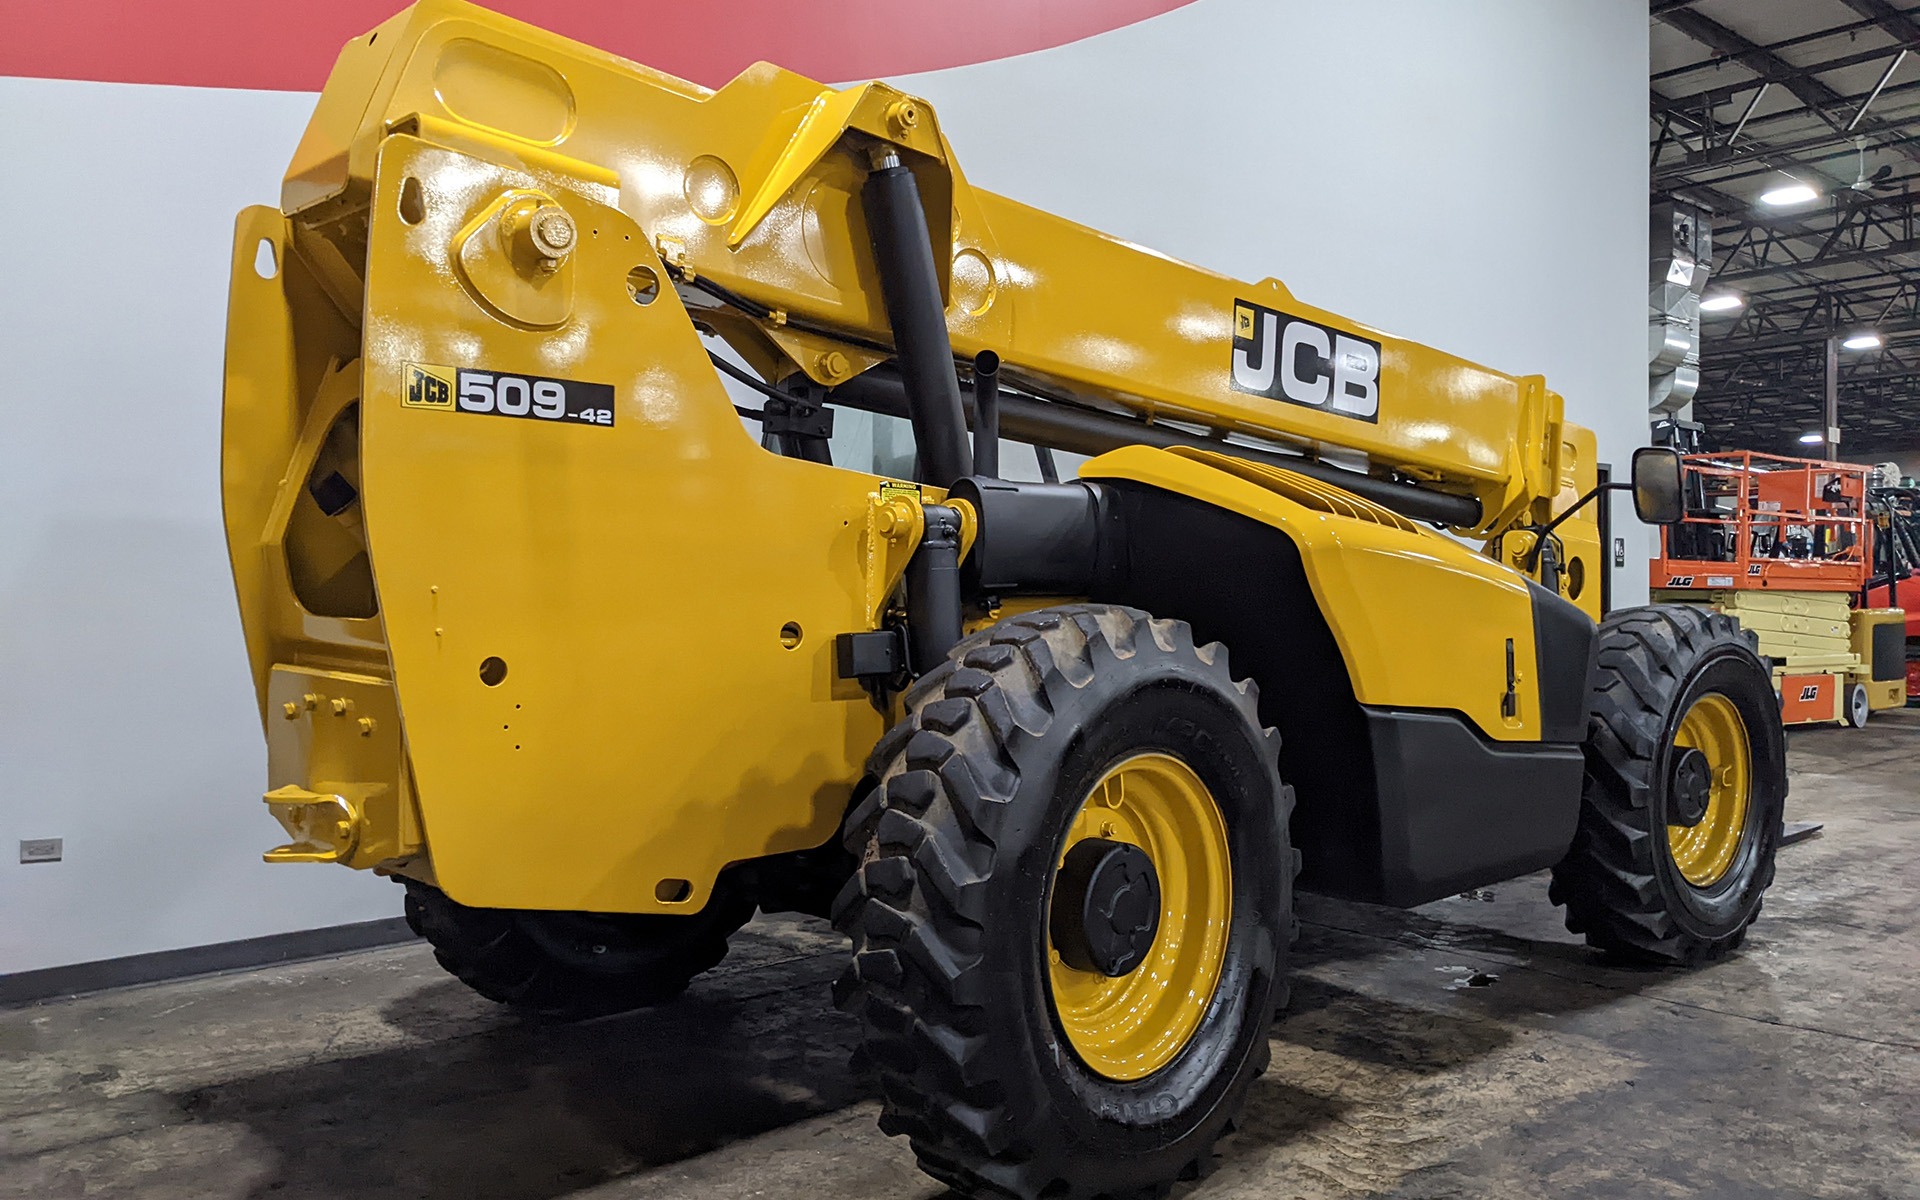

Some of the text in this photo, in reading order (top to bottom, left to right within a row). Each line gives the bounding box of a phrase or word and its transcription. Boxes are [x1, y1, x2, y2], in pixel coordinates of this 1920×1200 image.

[1233, 312, 1379, 417] JCB
[408, 369, 613, 425] JCB 509-42
[891, 482, 917, 490] WARNING
[1747, 564, 1761, 575] JLG
[1667, 576, 1694, 587] JLG
[1800, 686, 1818, 700] JLG
